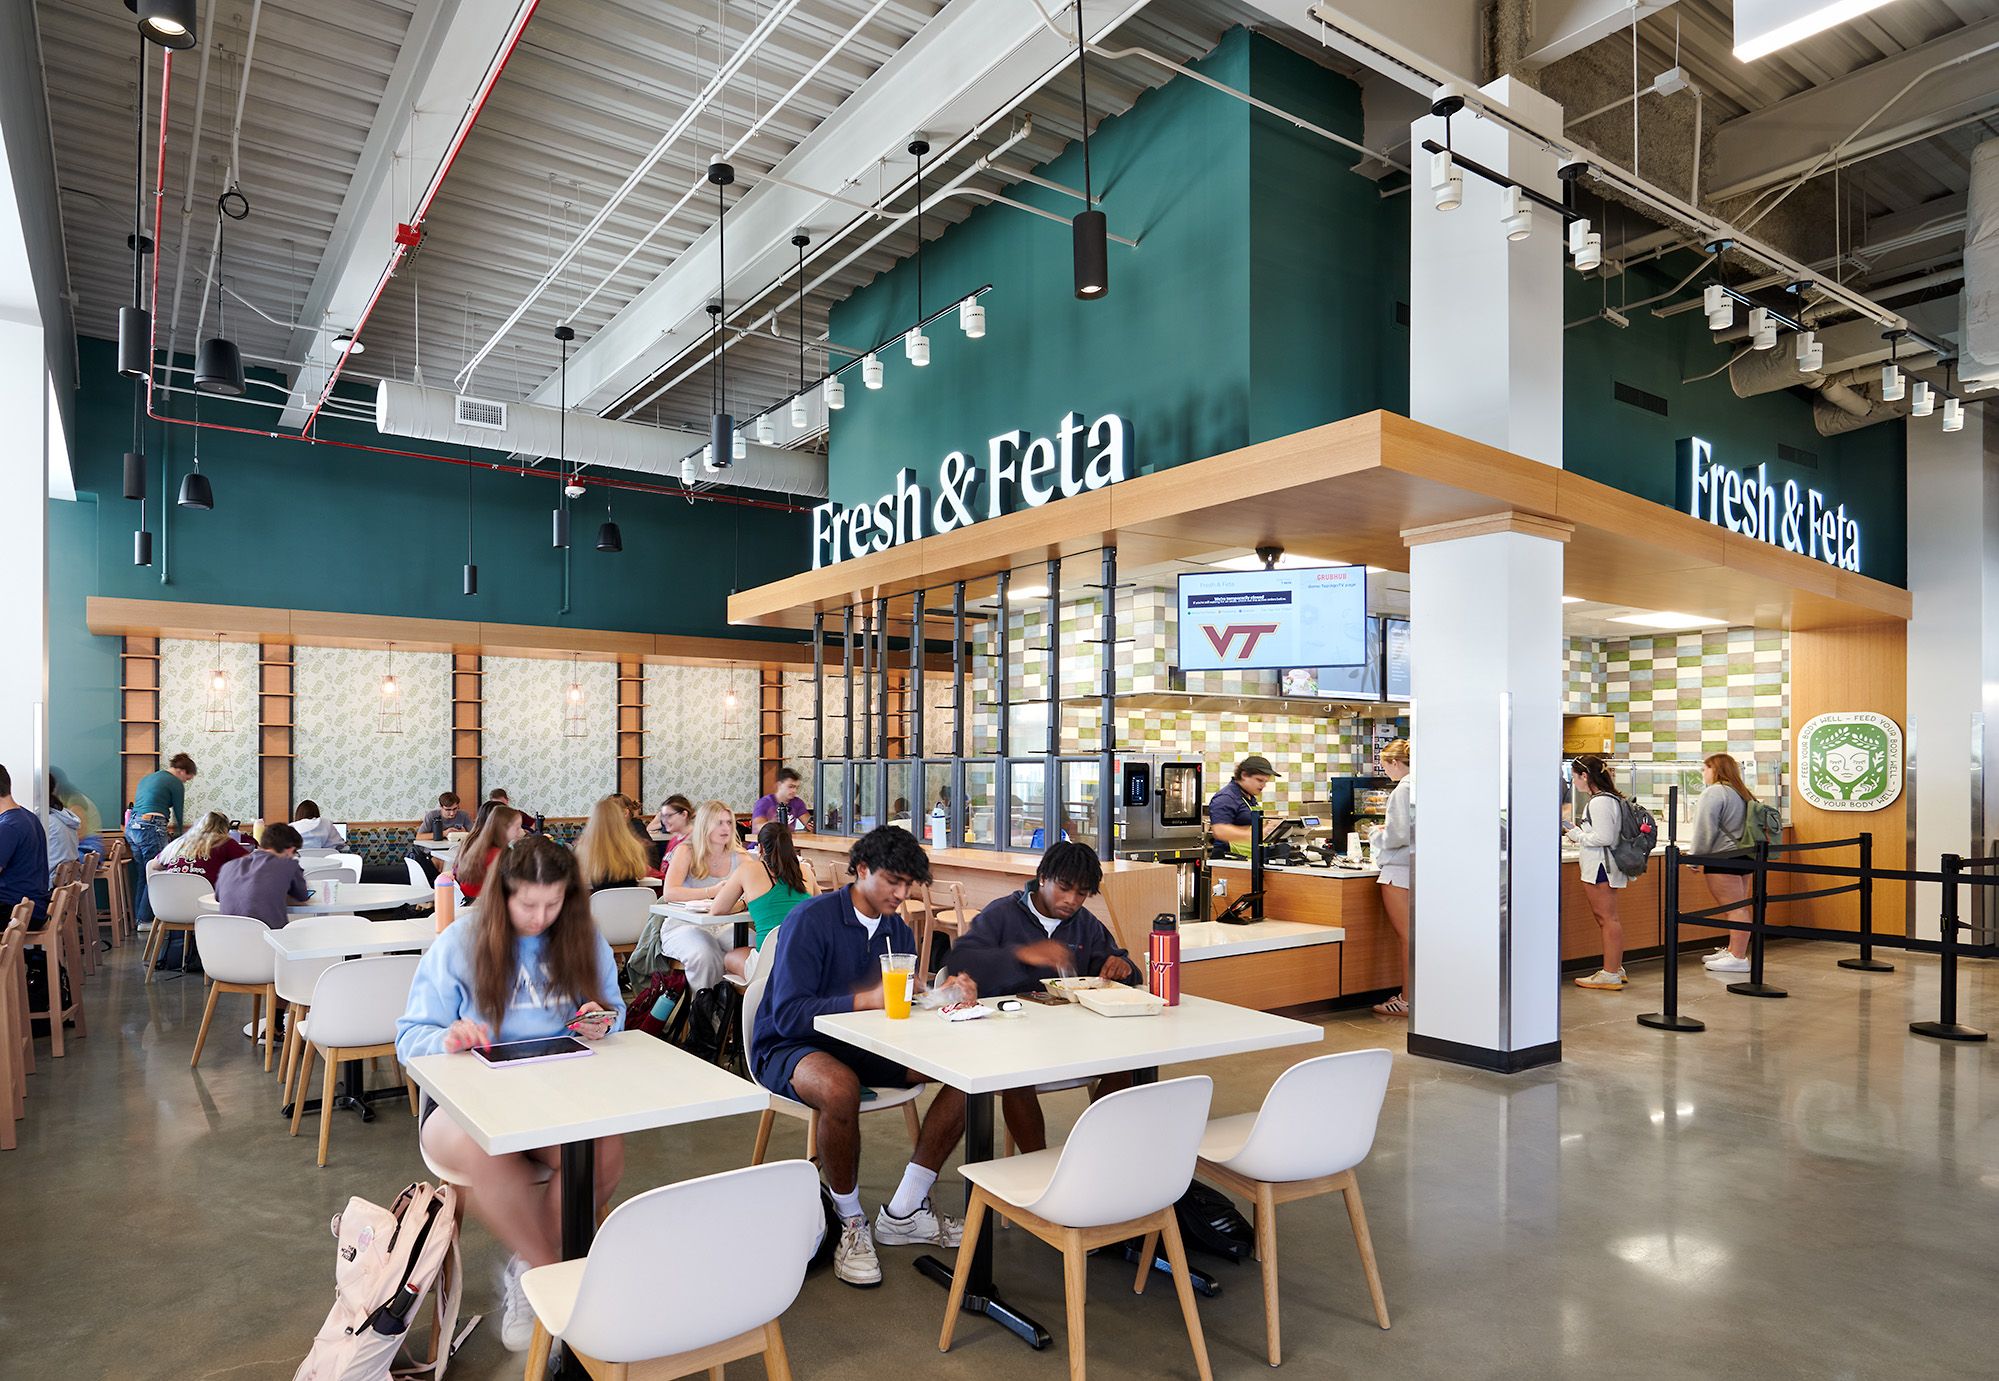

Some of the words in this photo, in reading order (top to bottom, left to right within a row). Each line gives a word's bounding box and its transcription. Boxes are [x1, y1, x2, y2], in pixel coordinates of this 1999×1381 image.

[812, 467, 925, 571] Fresh
[933, 450, 977, 535] &
[988, 410, 1127, 520] Feta
[1690, 436, 1775, 546] Fresh
[1781, 479, 1805, 555] &
[1808, 488, 1861, 573] Feta
[1316, 573, 1347, 581] GRUBHUB
[1199, 623, 1280, 661] VT
[1820, 715, 1842, 724] WELL
[1854, 714, 1877, 722] FEED
[1802, 722, 1818, 739] BODY
[1880, 719, 1897, 737] YOUR
[1801, 741, 1809, 759] YOUR
[1889, 739, 1899, 758] BODY
[1801, 761, 1809, 779] FEED
[1889, 760, 1898, 779] WELL
[1803, 787, 1821, 804] FEED
[1823, 799, 1847, 807] YOUR
[1849, 799, 1875, 807] BODY
[1877, 788, 1897, 805] WELL
[1151, 960, 1174, 974] VT
